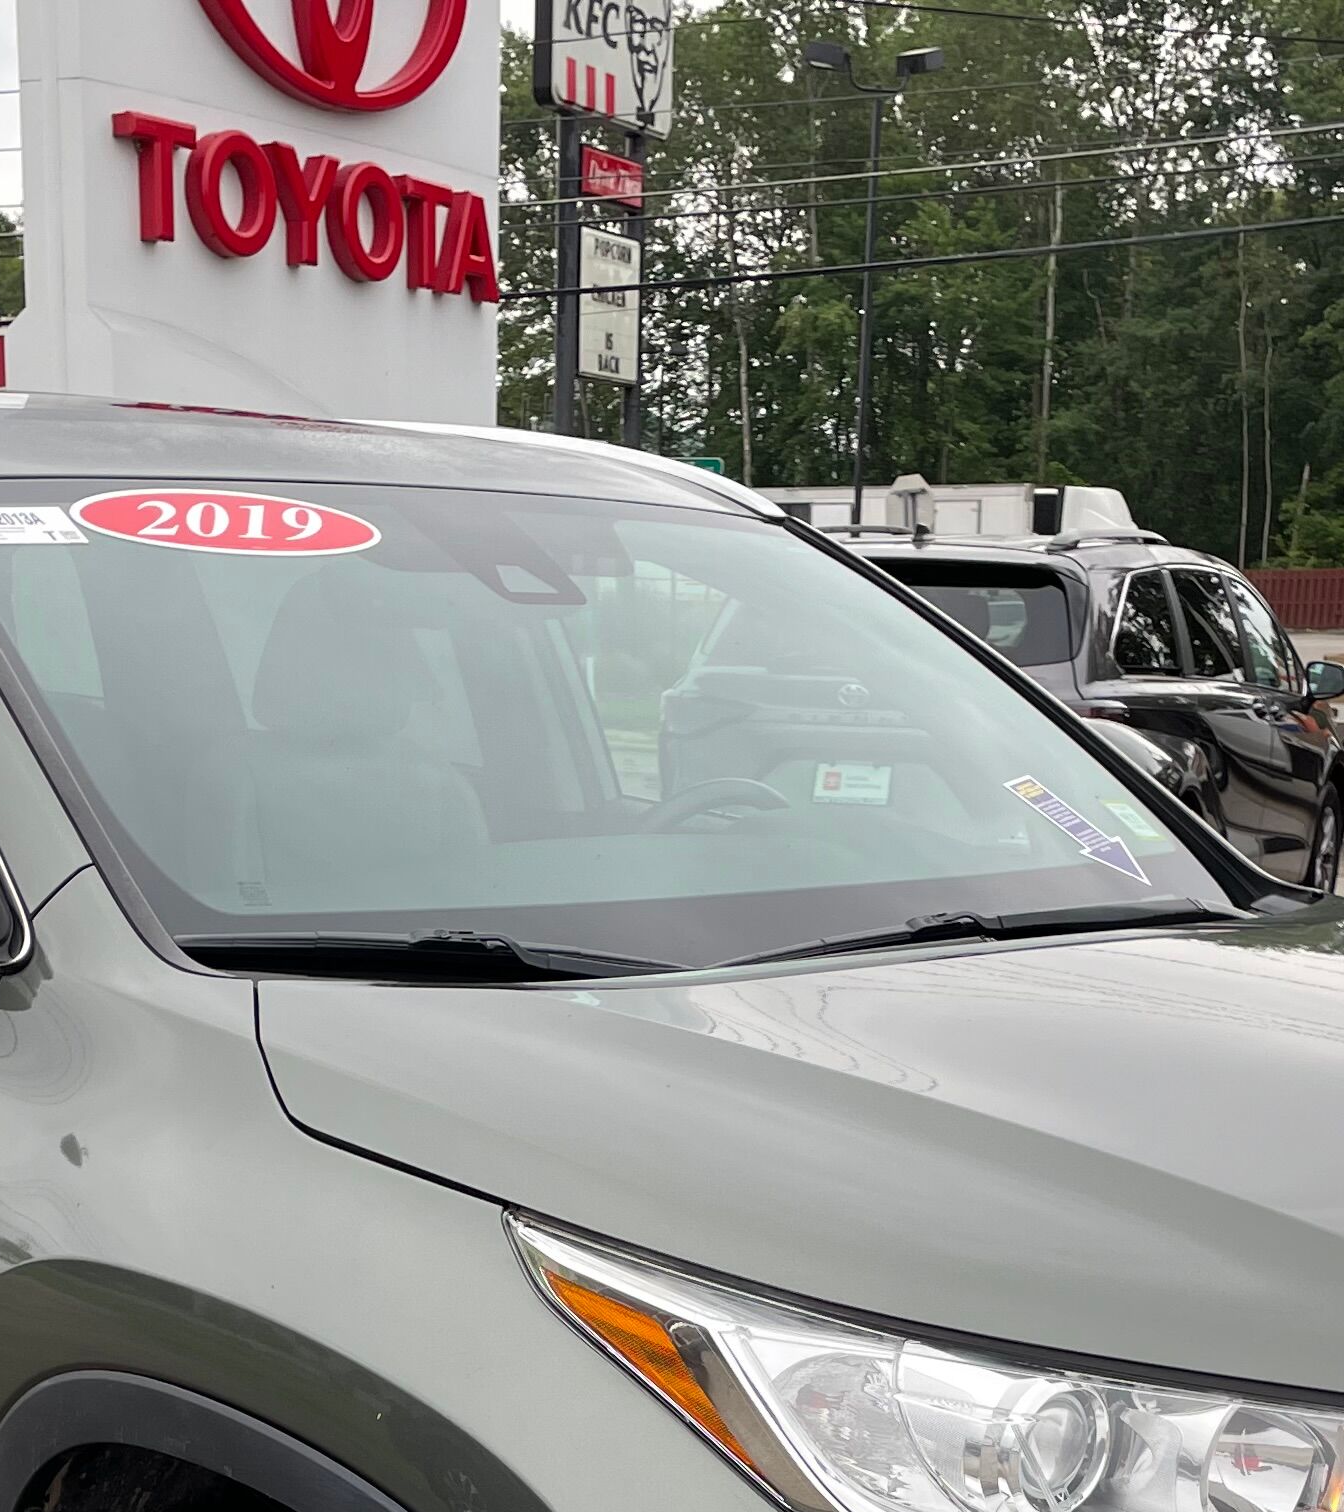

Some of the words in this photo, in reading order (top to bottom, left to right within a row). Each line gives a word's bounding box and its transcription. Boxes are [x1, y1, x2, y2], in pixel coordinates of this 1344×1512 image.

[563, 0, 619, 48] KFC
[112, 111, 499, 303] TOYOTA
[594, 238, 632, 264] POPCORN
[605, 332, 613, 350] IS
[598, 354, 619, 374] BACK
[136, 500, 323, 541] 2019
